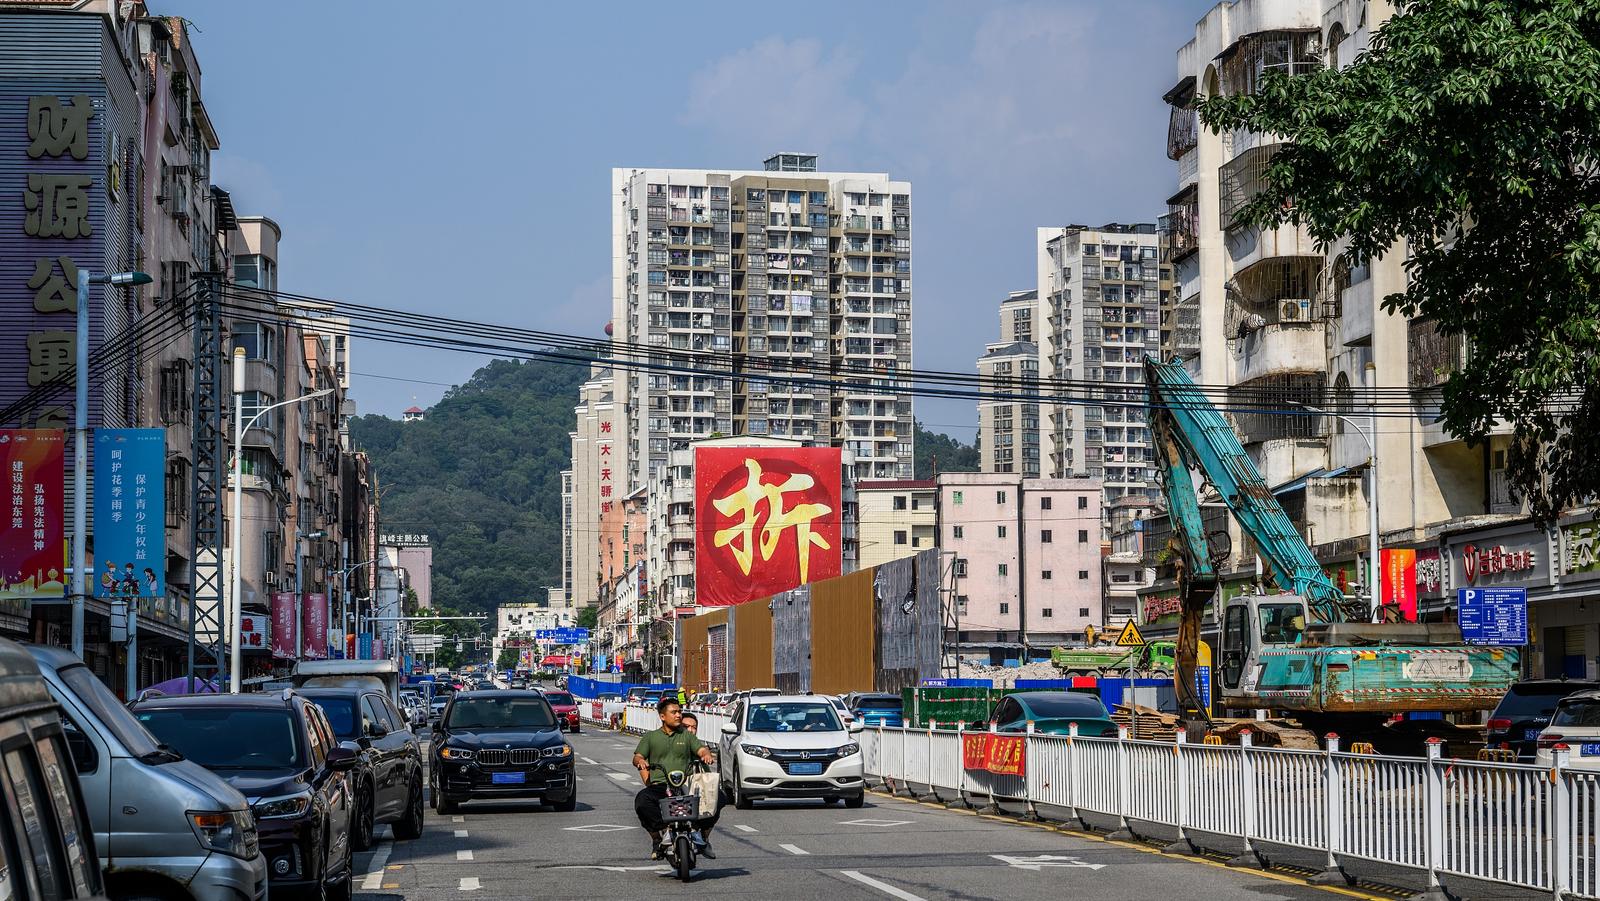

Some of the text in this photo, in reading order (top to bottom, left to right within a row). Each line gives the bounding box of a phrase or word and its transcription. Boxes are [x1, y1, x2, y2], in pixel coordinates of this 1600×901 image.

[12, 460, 23, 529] 建设法治东莞
[34, 483, 45, 551] 弘扬宪法精神
[112, 450, 123, 523] 呵护花季雨季
[135, 474, 147, 560] 保护青少年权益
[713, 458, 832, 585] 拆
[1465, 590, 1476, 605] P
